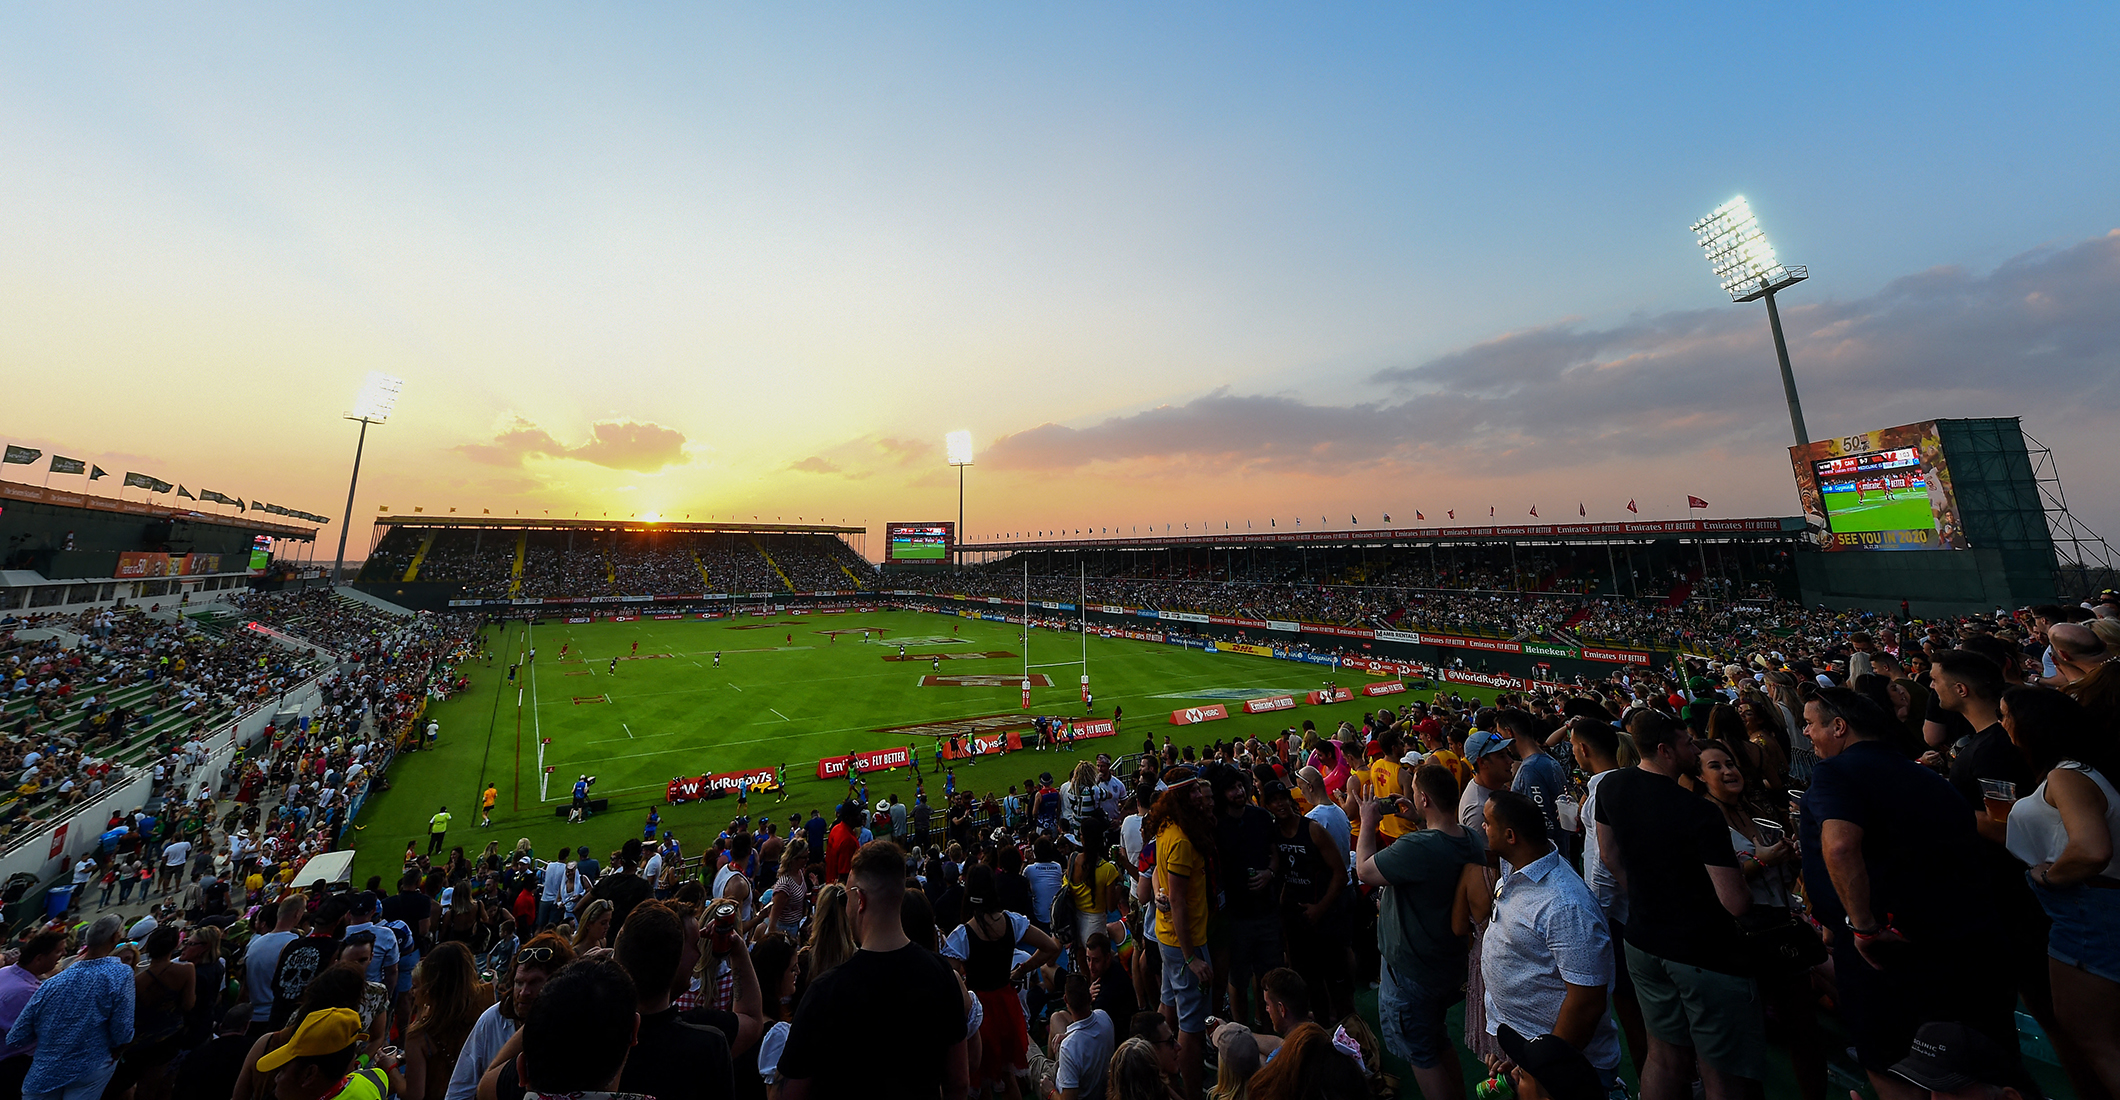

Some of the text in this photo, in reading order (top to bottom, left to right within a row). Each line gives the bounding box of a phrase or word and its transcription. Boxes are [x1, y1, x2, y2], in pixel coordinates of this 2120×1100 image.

[1497, 527, 1526, 535] Emirates
[1557, 525, 1590, 534] Emirates
[1601, 524, 1620, 532] BETTER
[1625, 521, 1696, 532] Emirates FLY BETTER
[1703, 520, 1778, 531] Emirates FLY BETTER
[1837, 530, 1928, 545] SEE YOU IN 2020
[1420, 636, 1444, 644] Emirates
[1469, 640, 1496, 649] Emirates
[1232, 644, 1254, 653] DHL
[1525, 645, 1566, 657] Heineken
[1584, 650, 1617, 661] Emirates
[1628, 654, 1646, 663] BETTER
[1448, 670, 1522, 688] @WorldRugby7s
[1203, 709, 1219, 717] HSBC
[1086, 725, 1094, 734] FLY
[1095, 723, 1112, 733] BETTER
[872, 755, 882, 766] FLY
[884, 751, 906, 765] BETTER
[1288, 854, 1296, 868] 9
